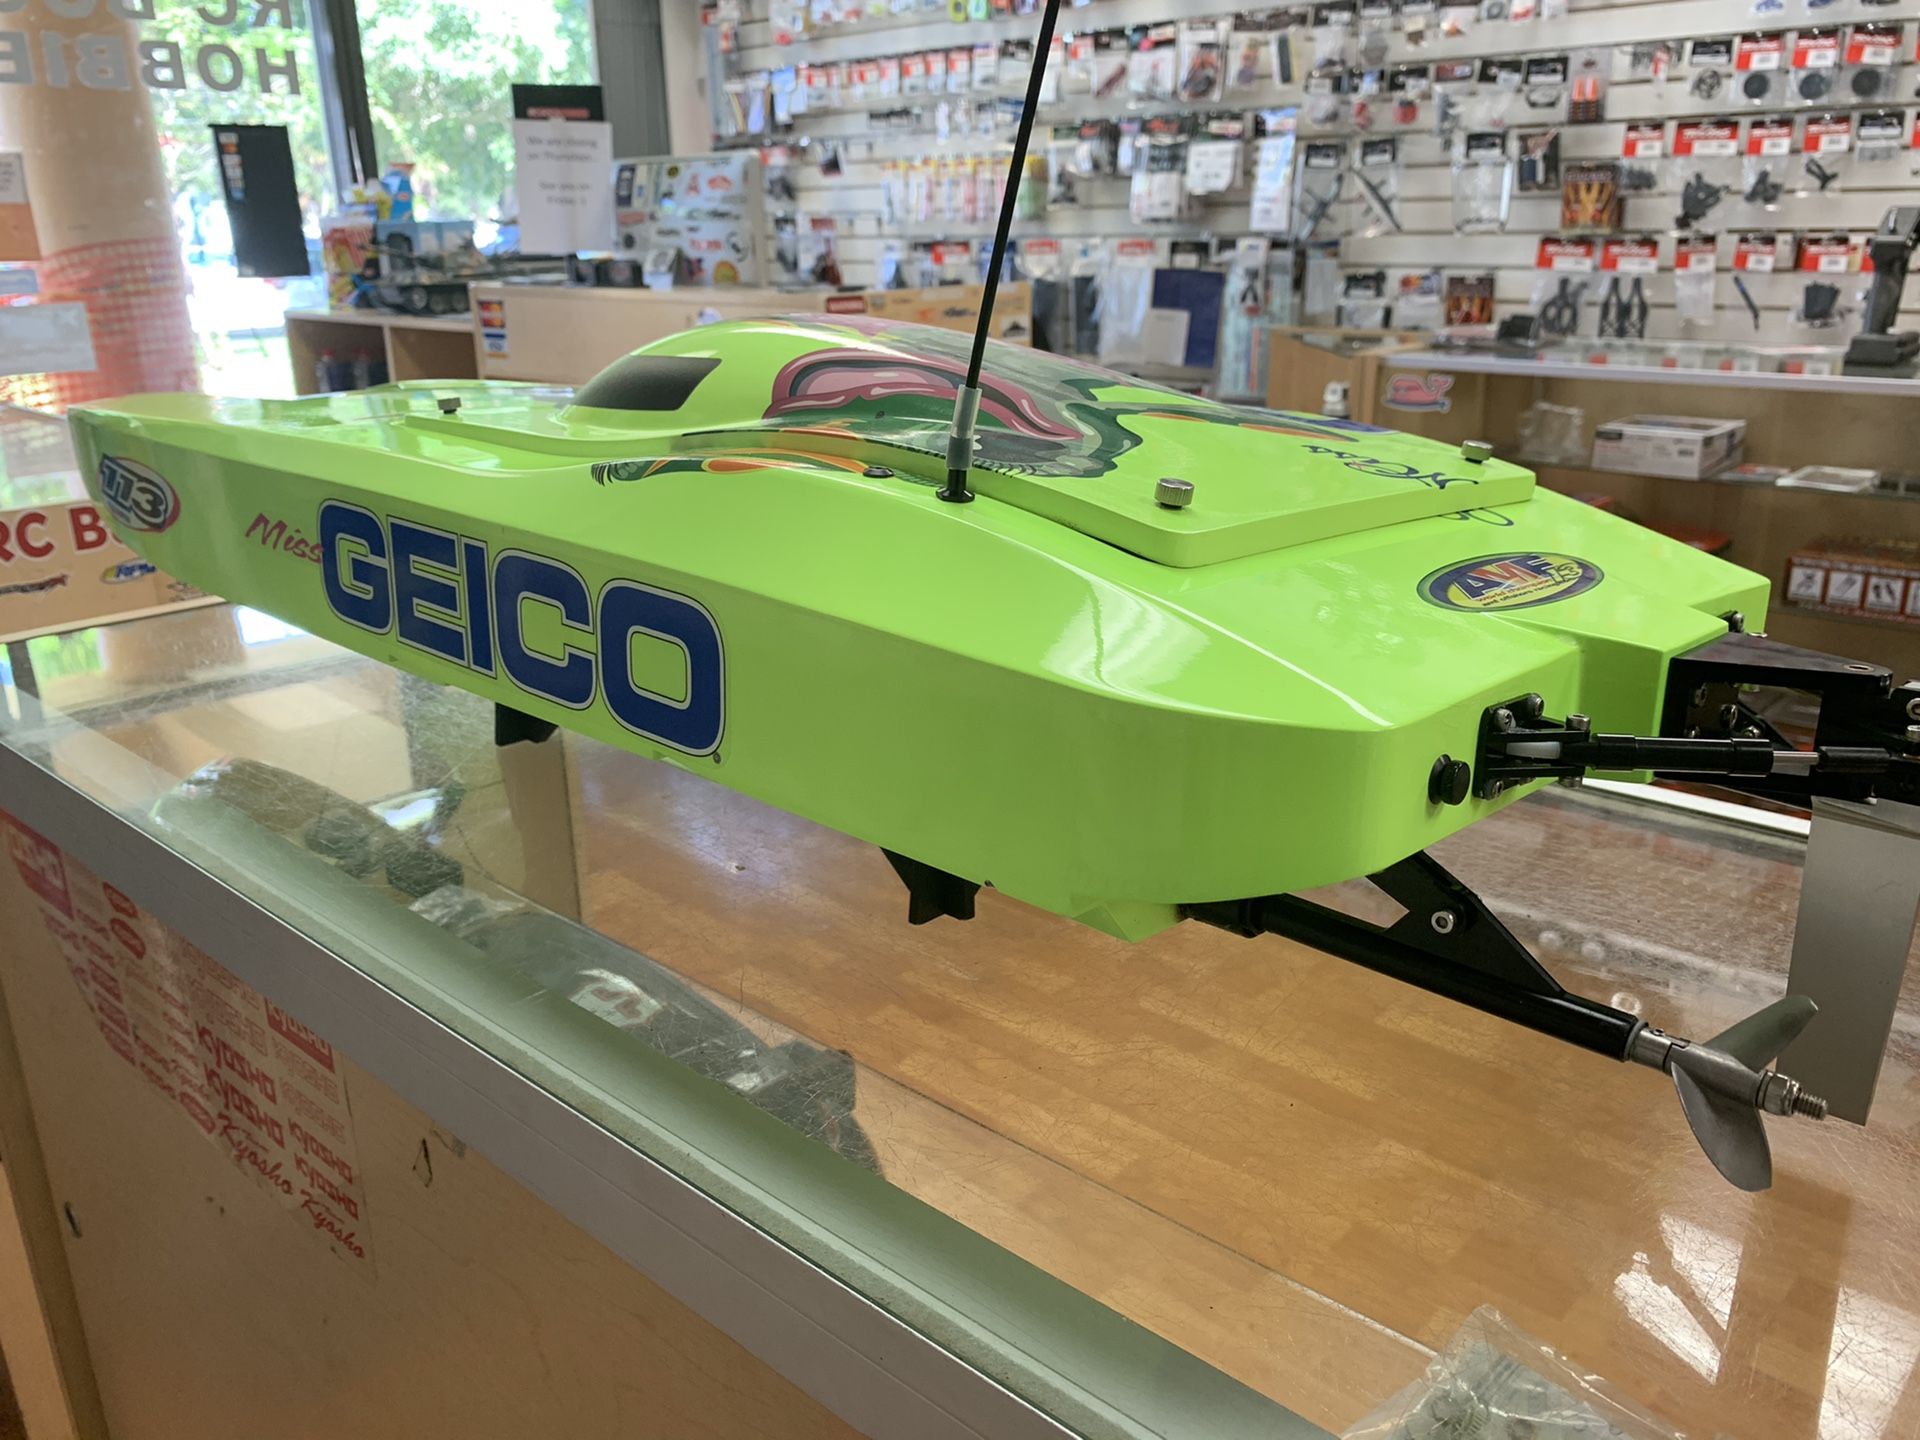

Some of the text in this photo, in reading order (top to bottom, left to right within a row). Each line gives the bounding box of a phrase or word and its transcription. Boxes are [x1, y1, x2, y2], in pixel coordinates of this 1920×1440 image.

[69, 506, 123, 551] B
[245, 497, 726, 758] Miss GEICO
[217, 1112, 294, 1196] Kyosho
[300, 1189, 365, 1258] Kyosho
